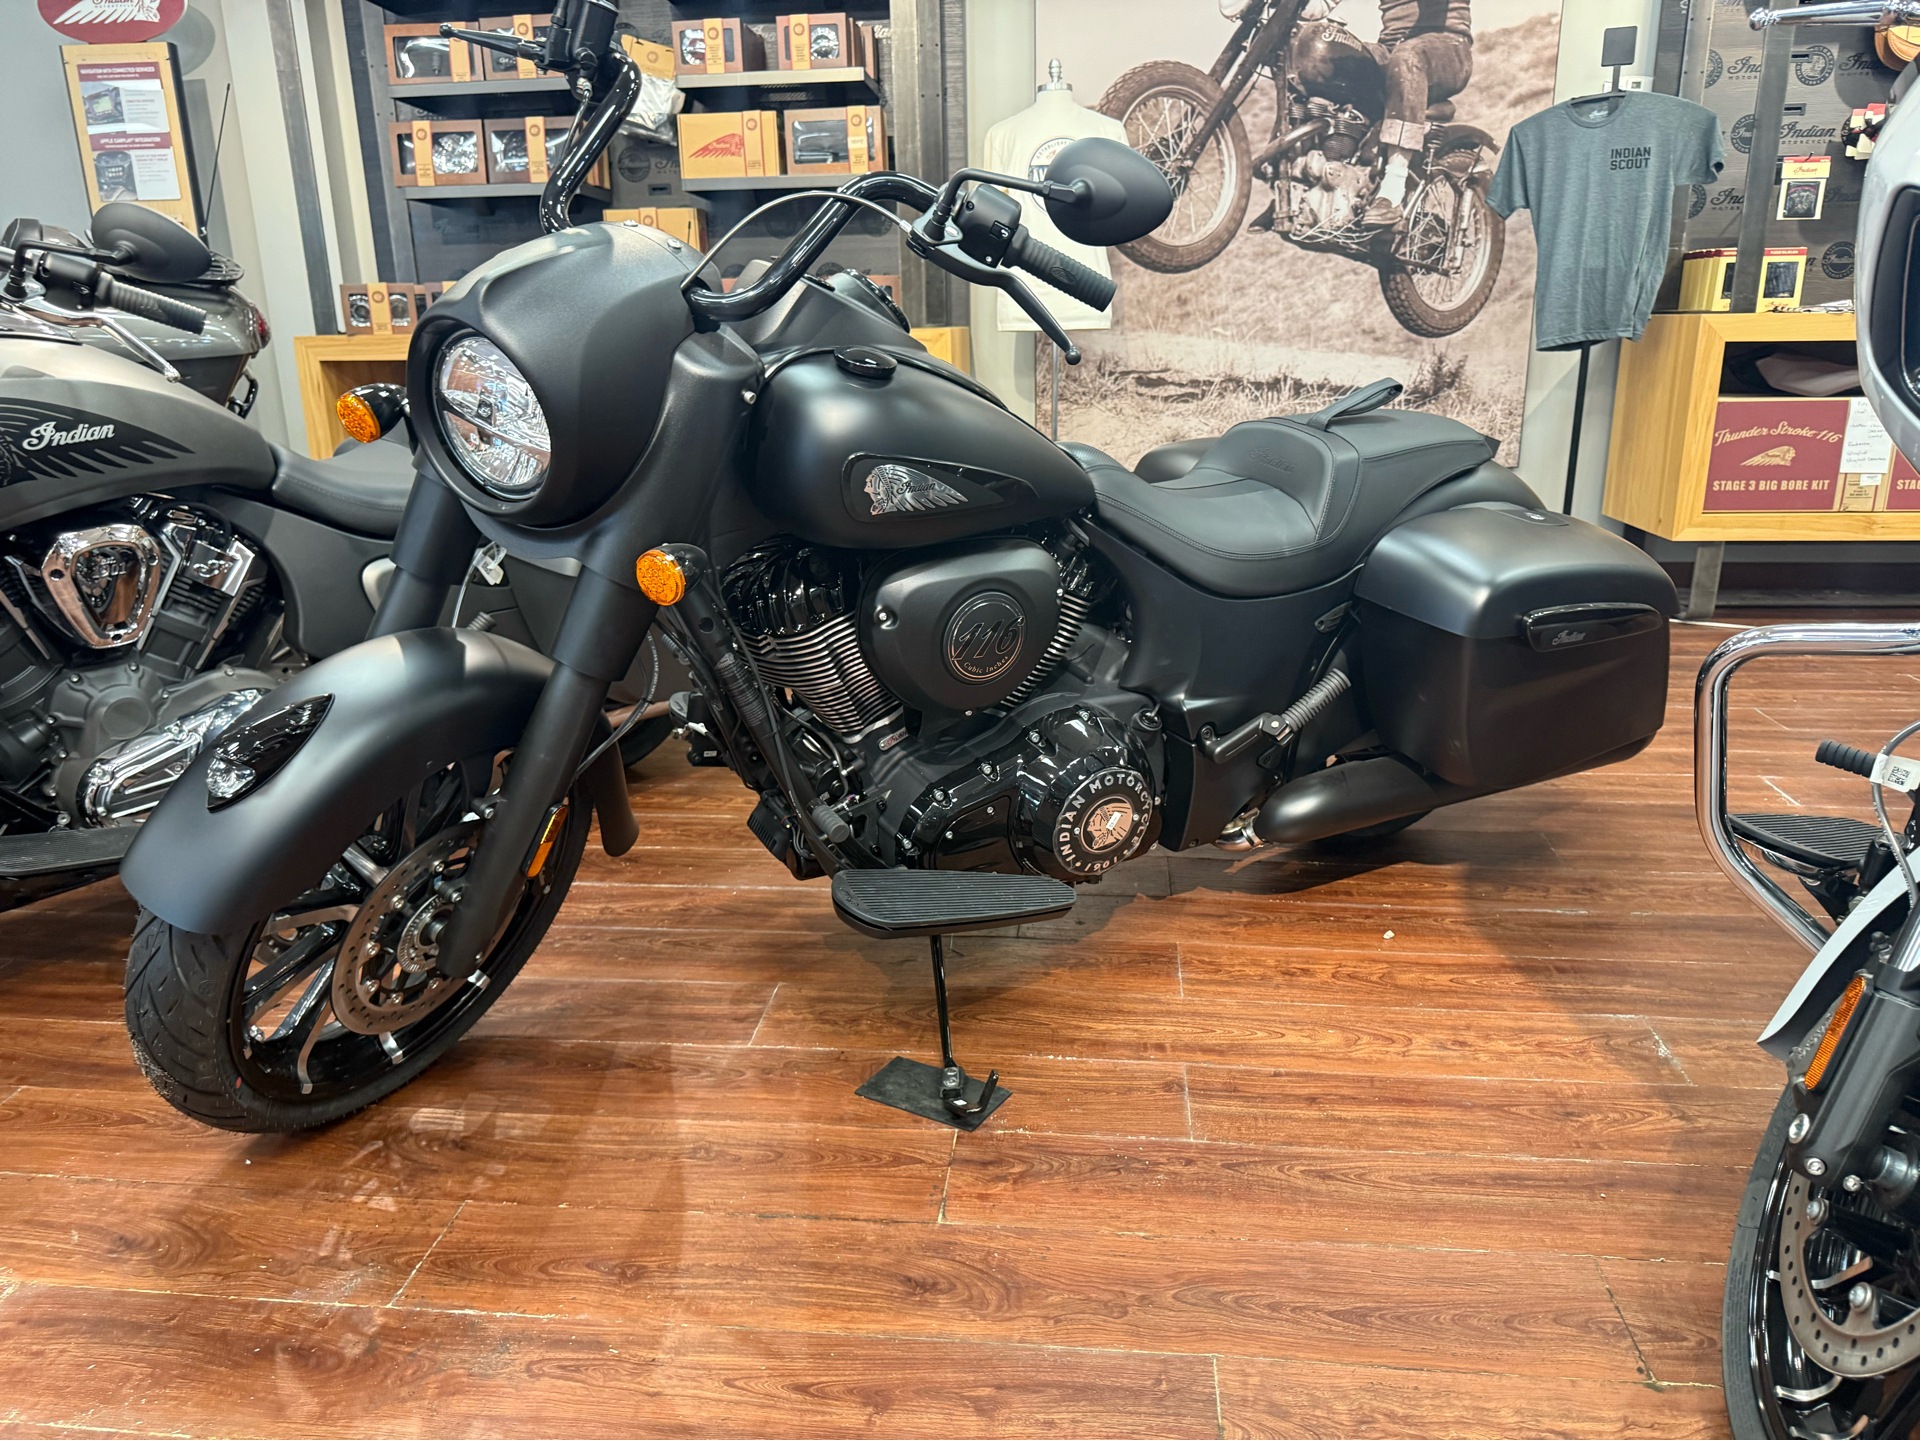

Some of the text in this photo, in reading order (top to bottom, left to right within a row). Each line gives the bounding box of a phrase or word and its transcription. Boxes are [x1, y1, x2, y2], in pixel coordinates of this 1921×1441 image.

[1322, 26, 1362, 51] Indian
[1611, 147, 1651, 159] INDIAN
[1610, 158, 1650, 170] SCOUT
[22, 421, 115, 450] Indian
[1715, 421, 1842, 446] Thunder Stroke 116
[897, 480, 936, 495] Indian
[1713, 480, 1830, 491] STAGE 3 BIG BORE KIT
[952, 616, 1025, 661] 116
[1552, 630, 1586, 645] Indian
[964, 656, 1009, 673] Cubic Inches
[1060, 773, 1151, 862] INDIAN MOTORCYCLE
[1084, 856, 1118, 872] 1901
